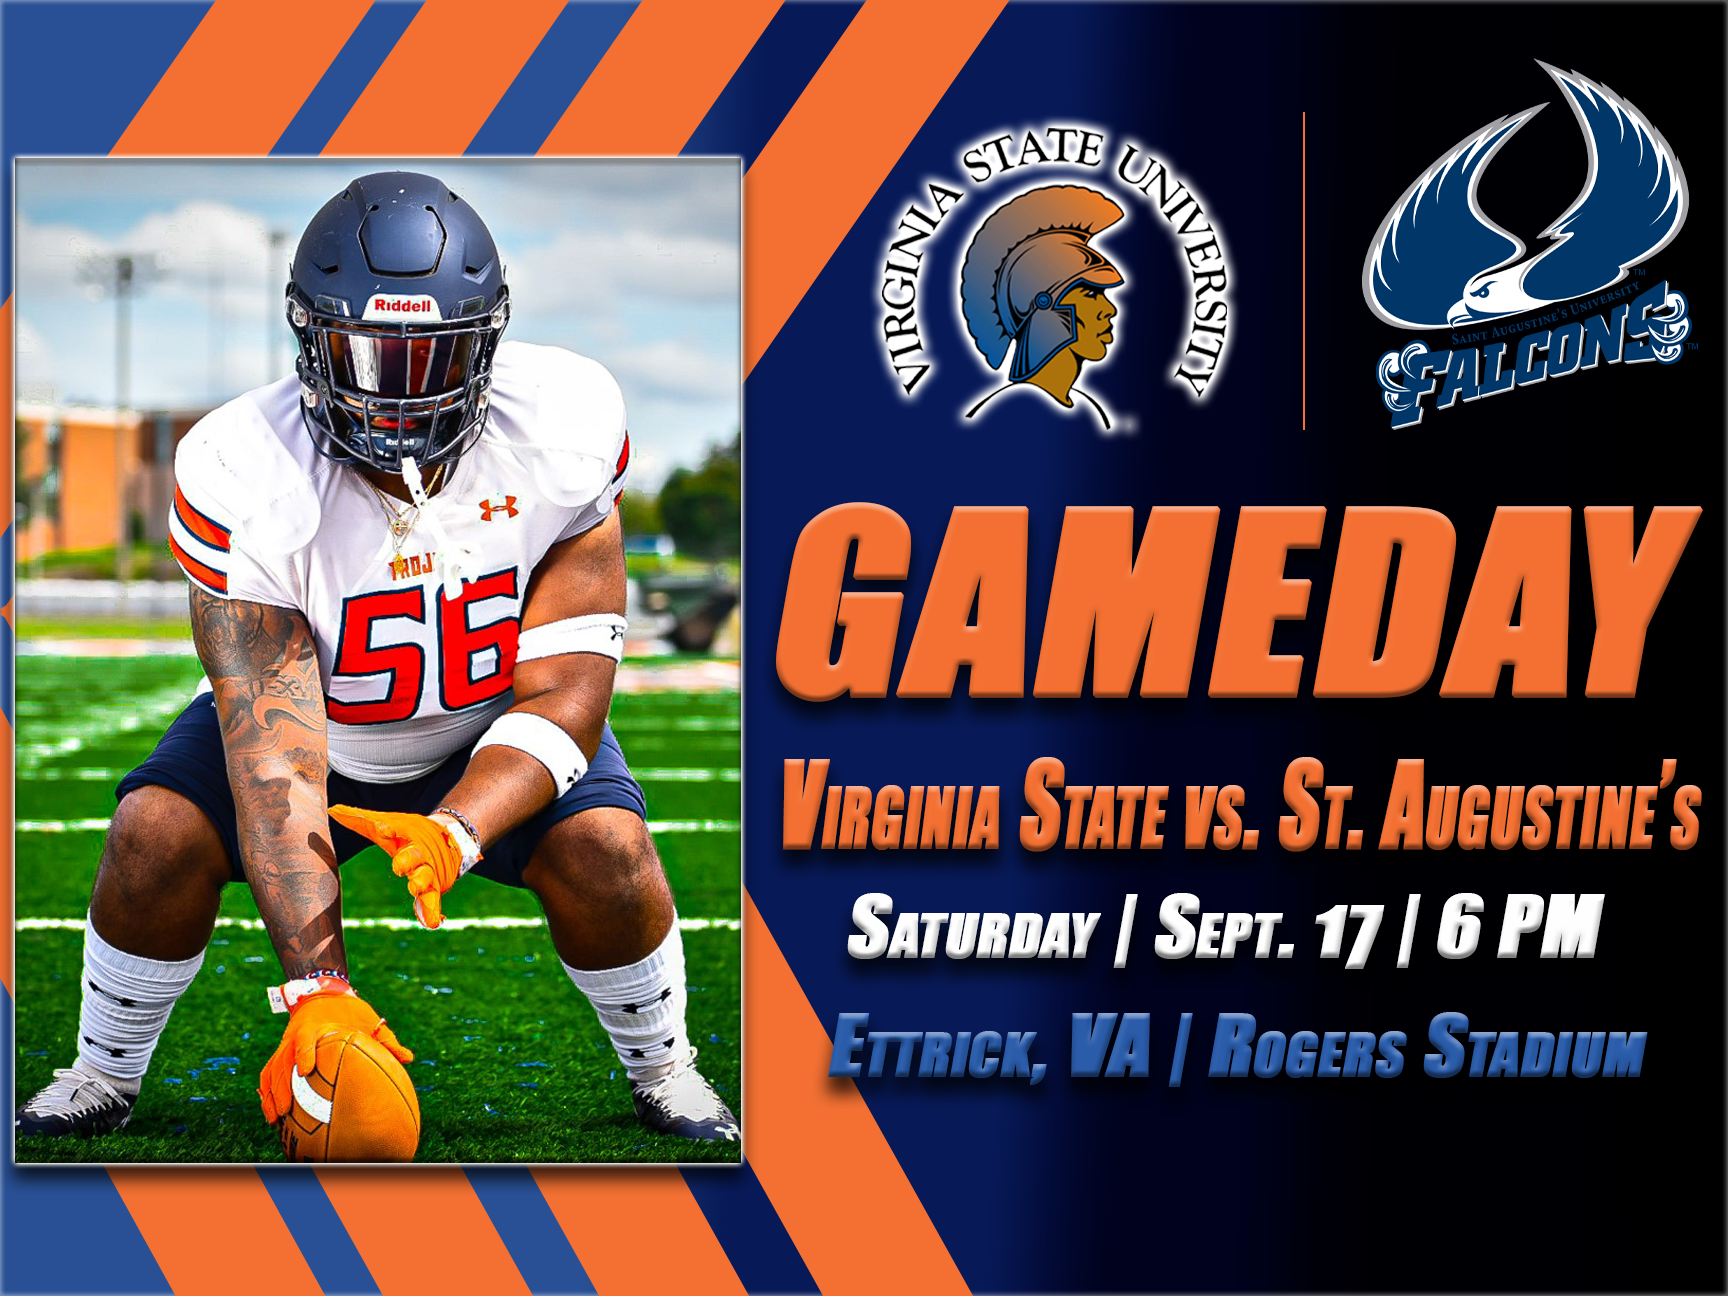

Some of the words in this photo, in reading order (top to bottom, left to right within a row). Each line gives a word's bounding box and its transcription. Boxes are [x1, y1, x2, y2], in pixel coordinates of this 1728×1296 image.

[374, 298, 432, 313] Riddell
[385, 438, 415, 446] Ridell
[327, 565, 521, 726] 56
